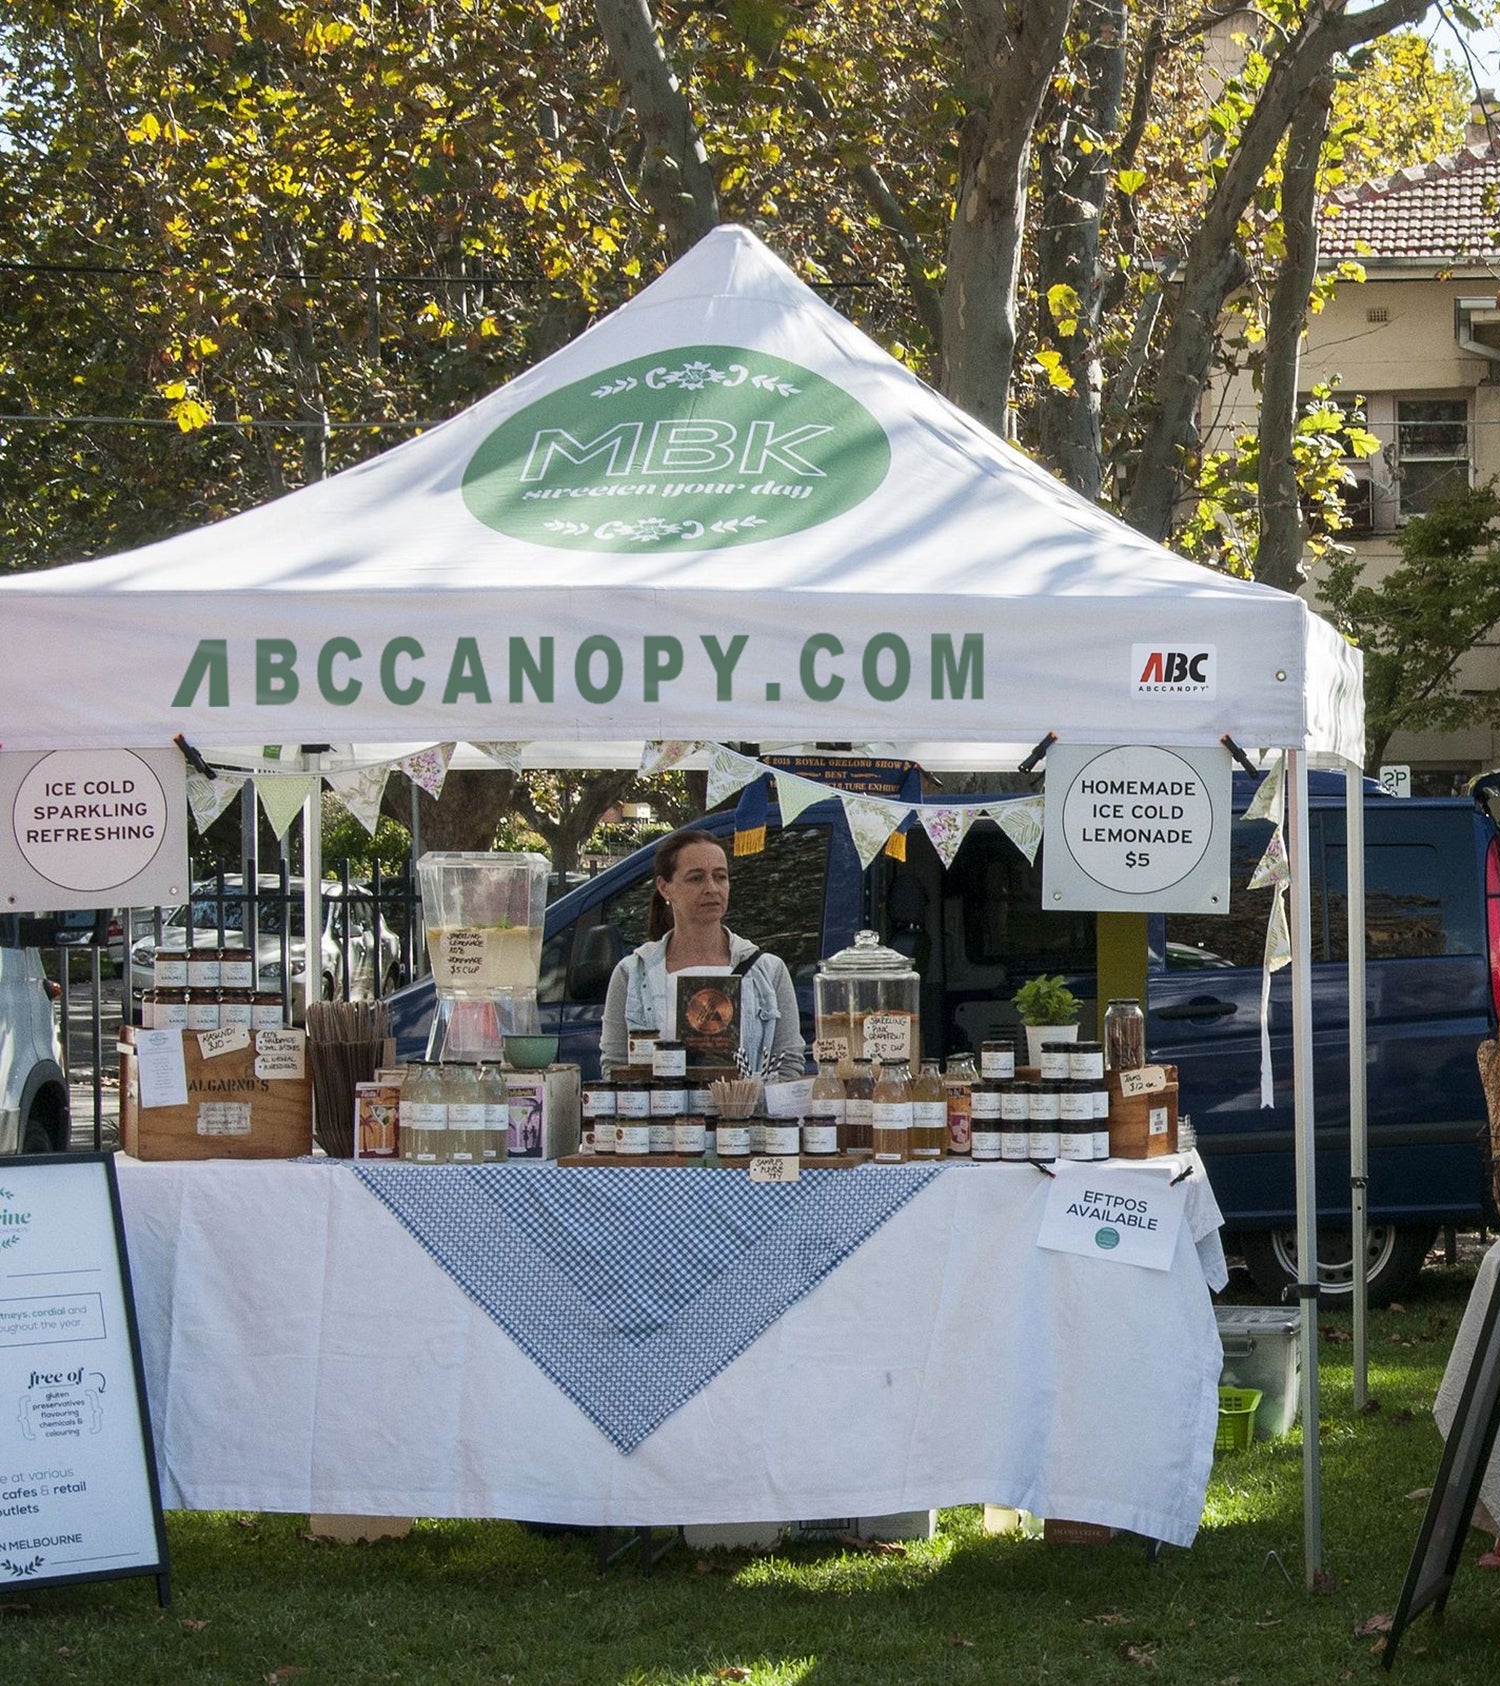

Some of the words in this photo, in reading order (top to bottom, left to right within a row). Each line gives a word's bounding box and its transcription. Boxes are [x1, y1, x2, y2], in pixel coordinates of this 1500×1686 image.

[520, 419, 834, 483] MBK
[522, 483, 657, 500] sweeten
[659, 482, 745, 499] your
[750, 480, 813, 499] day
[170, 632, 985, 707] ABCCANOPY.COM
[1140, 653, 1209, 683] ABC
[795, 758, 826, 767] ROYAL
[829, 759, 872, 768] GEELONG
[875, 760, 902, 769] SHOW
[825, 771, 847, 779] BEST
[1384, 772, 1407, 786] 2P
[46, 783, 76, 796] ICE
[83, 780, 135, 795] COLD
[1081, 780, 1195, 796] HOMEMADE
[33, 803, 147, 820] SPARKLING
[1093, 804, 1124, 818] ICE
[1131, 805, 1183, 819] COLD
[26, 825, 155, 843] REFRESHING
[1082, 828, 1192, 843] LEMONADE
[1125, 851, 1150, 868] $5
[874, 1043, 886, 1052] $5
[1083, 1190, 1147, 1213] EFTPOS
[1066, 1203, 1158, 1231] AVAILABLE
[32, 1307, 65, 1318] cordial
[68, 1306, 87, 1315] and
[40, 1320, 57, 1329] the
[28, 1371, 62, 1389] free
[67, 1368, 84, 1385] of
[45, 1391, 70, 1401] gluten
[32, 1399, 85, 1411] preservatives
[41, 1409, 79, 1418] flavouring
[39, 1419, 76, 1428] chemicals
[45, 1428, 80, 1437] colouring
[11, 1473, 24, 1483] at
[28, 1467, 74, 1481] various
[2, 1487, 38, 1500] cafes
[40, 1484, 50, 1496] &
[53, 1481, 87, 1495] retail
[8, 1533, 83, 1551] MELBOURNE
